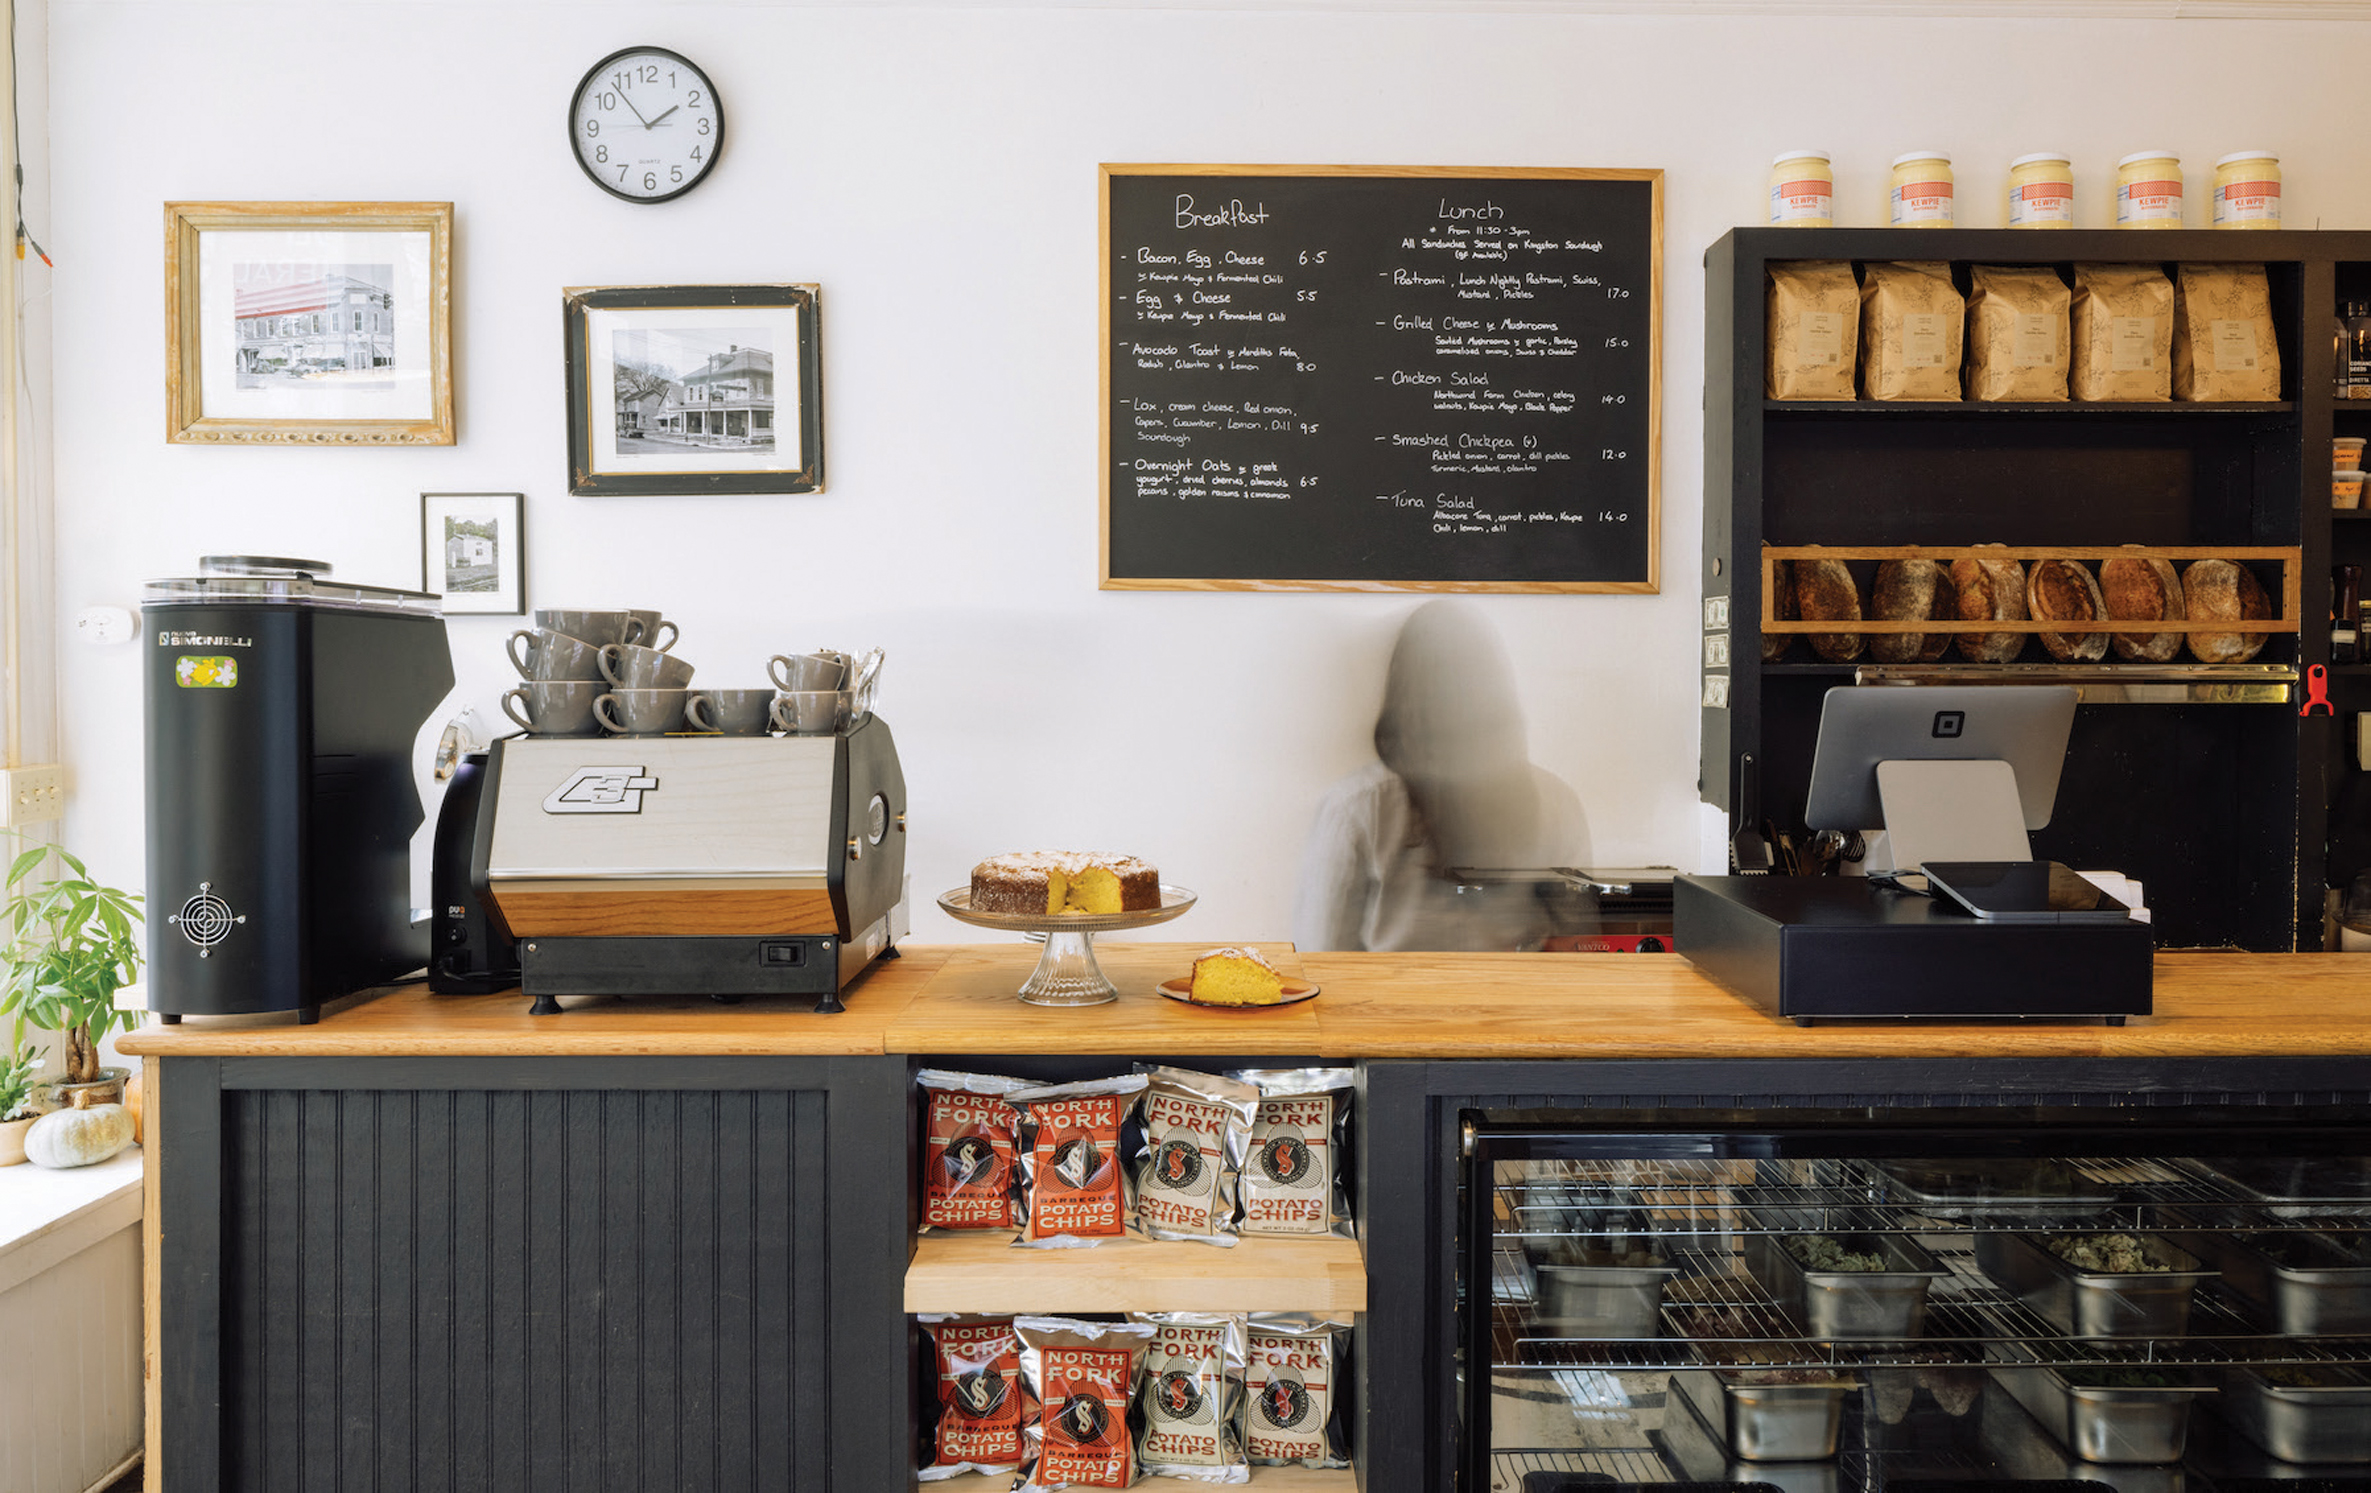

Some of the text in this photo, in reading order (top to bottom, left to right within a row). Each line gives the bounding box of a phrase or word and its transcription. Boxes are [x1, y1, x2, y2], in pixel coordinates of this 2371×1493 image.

[614, 71, 631, 90] 11
[636, 65, 658, 83] 12
[668, 71, 676, 89] 1
[595, 92, 616, 111] 10
[688, 90, 701, 108] 2
[586, 119, 599, 138] 9
[697, 117, 710, 136] 3
[596, 145, 608, 163] 8
[689, 145, 702, 163] 4
[616, 164, 629, 183] 7
[643, 172, 656, 191] 6
[670, 165, 683, 183] 5
[1439, 199, 1503, 219] Lunch
[1790, 196, 1818, 206] KEWPIE
[1911, 198, 1940, 207] KEWPIE
[2031, 198, 2061, 208] KEWPIE
[2139, 197, 2169, 207] KEWPIE
[2235, 197, 2265, 207] KEWPIE
[1176, 194, 1269, 228] Breakfast
[1448, 225, 1470, 235] From
[1402, 238, 1415, 248] All
[1474, 240, 1501, 249] Served
[1524, 239, 1558, 254] Kingston
[1225, 251, 1264, 265] Cheese
[1460, 273, 1486, 285] Lunch
[1136, 289, 1162, 311] Egg
[1193, 291, 1230, 304] Cheese
[1394, 315, 1558, 331] Grilled Cheese Mushrooms
[1132, 343, 1220, 356] Avocado Toast
[1231, 361, 1259, 370] Lemon
[1392, 370, 1488, 385] Chicken Salad
[1272, 420, 1290, 430] Dill
[1138, 431, 1191, 447] Sourdough
[1393, 434, 1448, 447] Smashed
[1458, 433, 1514, 452] Chickpea
[1135, 458, 1193, 478] Overnight
[1202, 459, 1231, 471] Oats
[1250, 477, 1288, 487] almonds
[1178, 487, 1206, 500] golden
[1392, 490, 1474, 509] Tuna Salad
[171, 635, 252, 647] SIMONELLI
[937, 1094, 1011, 1111] NORTH
[1036, 1099, 1113, 1113] NORTH
[1154, 1098, 1226, 1119] NORTH
[934, 1107, 1007, 1128] FORK
[1149, 1111, 1221, 1135] FORK
[930, 1199, 1004, 1210] POTATO
[1041, 1195, 1116, 1203] BARBEQUE
[1139, 1194, 1207, 1218] POTATO
[1250, 1199, 1323, 1209] POTATO
[928, 1209, 1003, 1222] CHIPS
[1040, 1202, 1116, 1216] POTATO
[1138, 1205, 1205, 1228] CHIPS
[1249, 1210, 1321, 1221] CHIPS
[1039, 1214, 1114, 1228] CHIPS
[941, 1339, 1017, 1357] FORK
[1148, 1342, 1217, 1360] FORK
[1249, 1338, 1321, 1351] NORTH
[1048, 1351, 1125, 1367] NORTH
[1248, 1352, 1322, 1370] FORK
[1046, 1366, 1122, 1384] FORK
[945, 1431, 1017, 1444] POTATO
[1150, 1429, 1215, 1446] POTATO
[1249, 1436, 1320, 1450] POTATO
[943, 1443, 1017, 1457] CHIPS
[1147, 1441, 1215, 1456] CHIPS
[1249, 1446, 1318, 1459] CHIPS
[1046, 1457, 1121, 1471] POTATO
[1045, 1469, 1119, 1483] CHIPS
